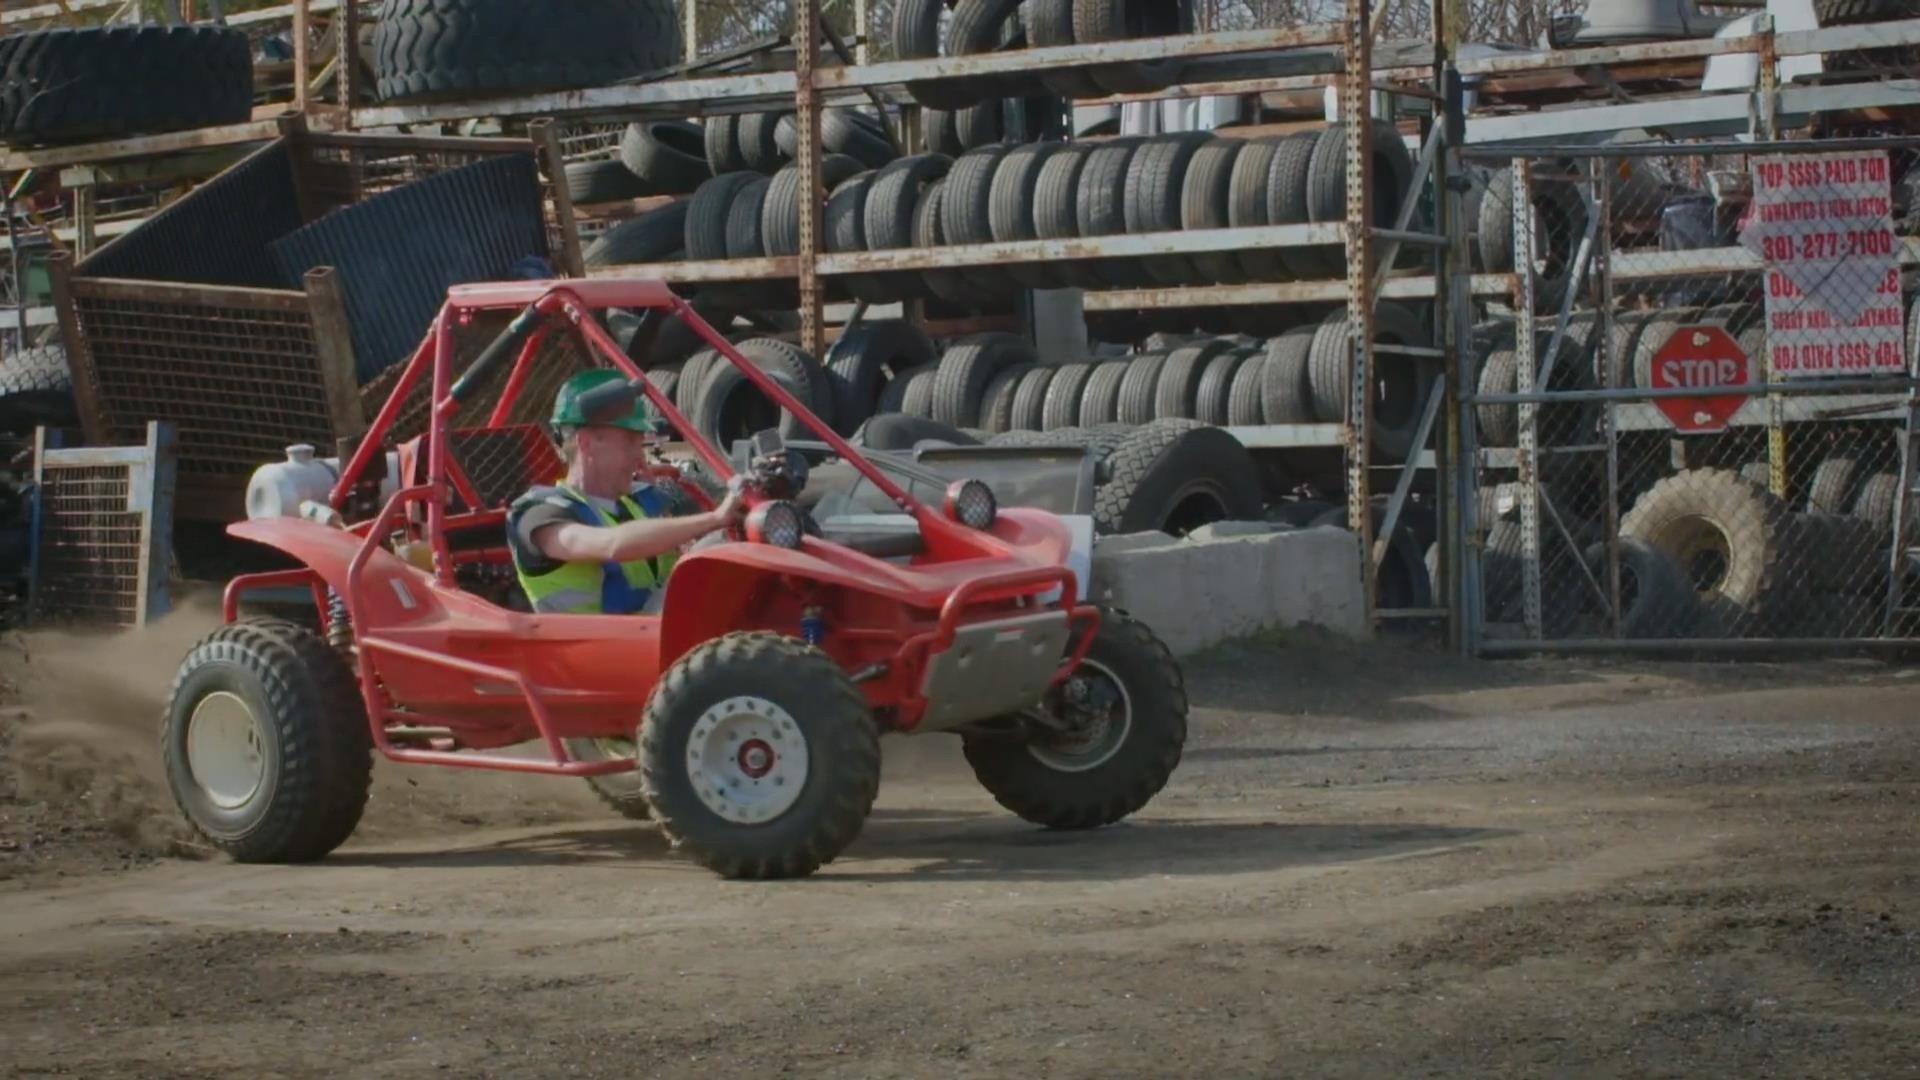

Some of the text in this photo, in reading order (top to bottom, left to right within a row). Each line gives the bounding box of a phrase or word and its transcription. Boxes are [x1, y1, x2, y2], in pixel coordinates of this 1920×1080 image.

[1757, 163, 1784, 188] TOP
[1825, 159, 1856, 185] PAID
[1860, 157, 1885, 183] FOR
[1773, 345, 1799, 371] FOR
[1802, 345, 1834, 370] PAID
[1875, 340, 1901, 366] TOP
[1661, 358, 1737, 388] STOP
